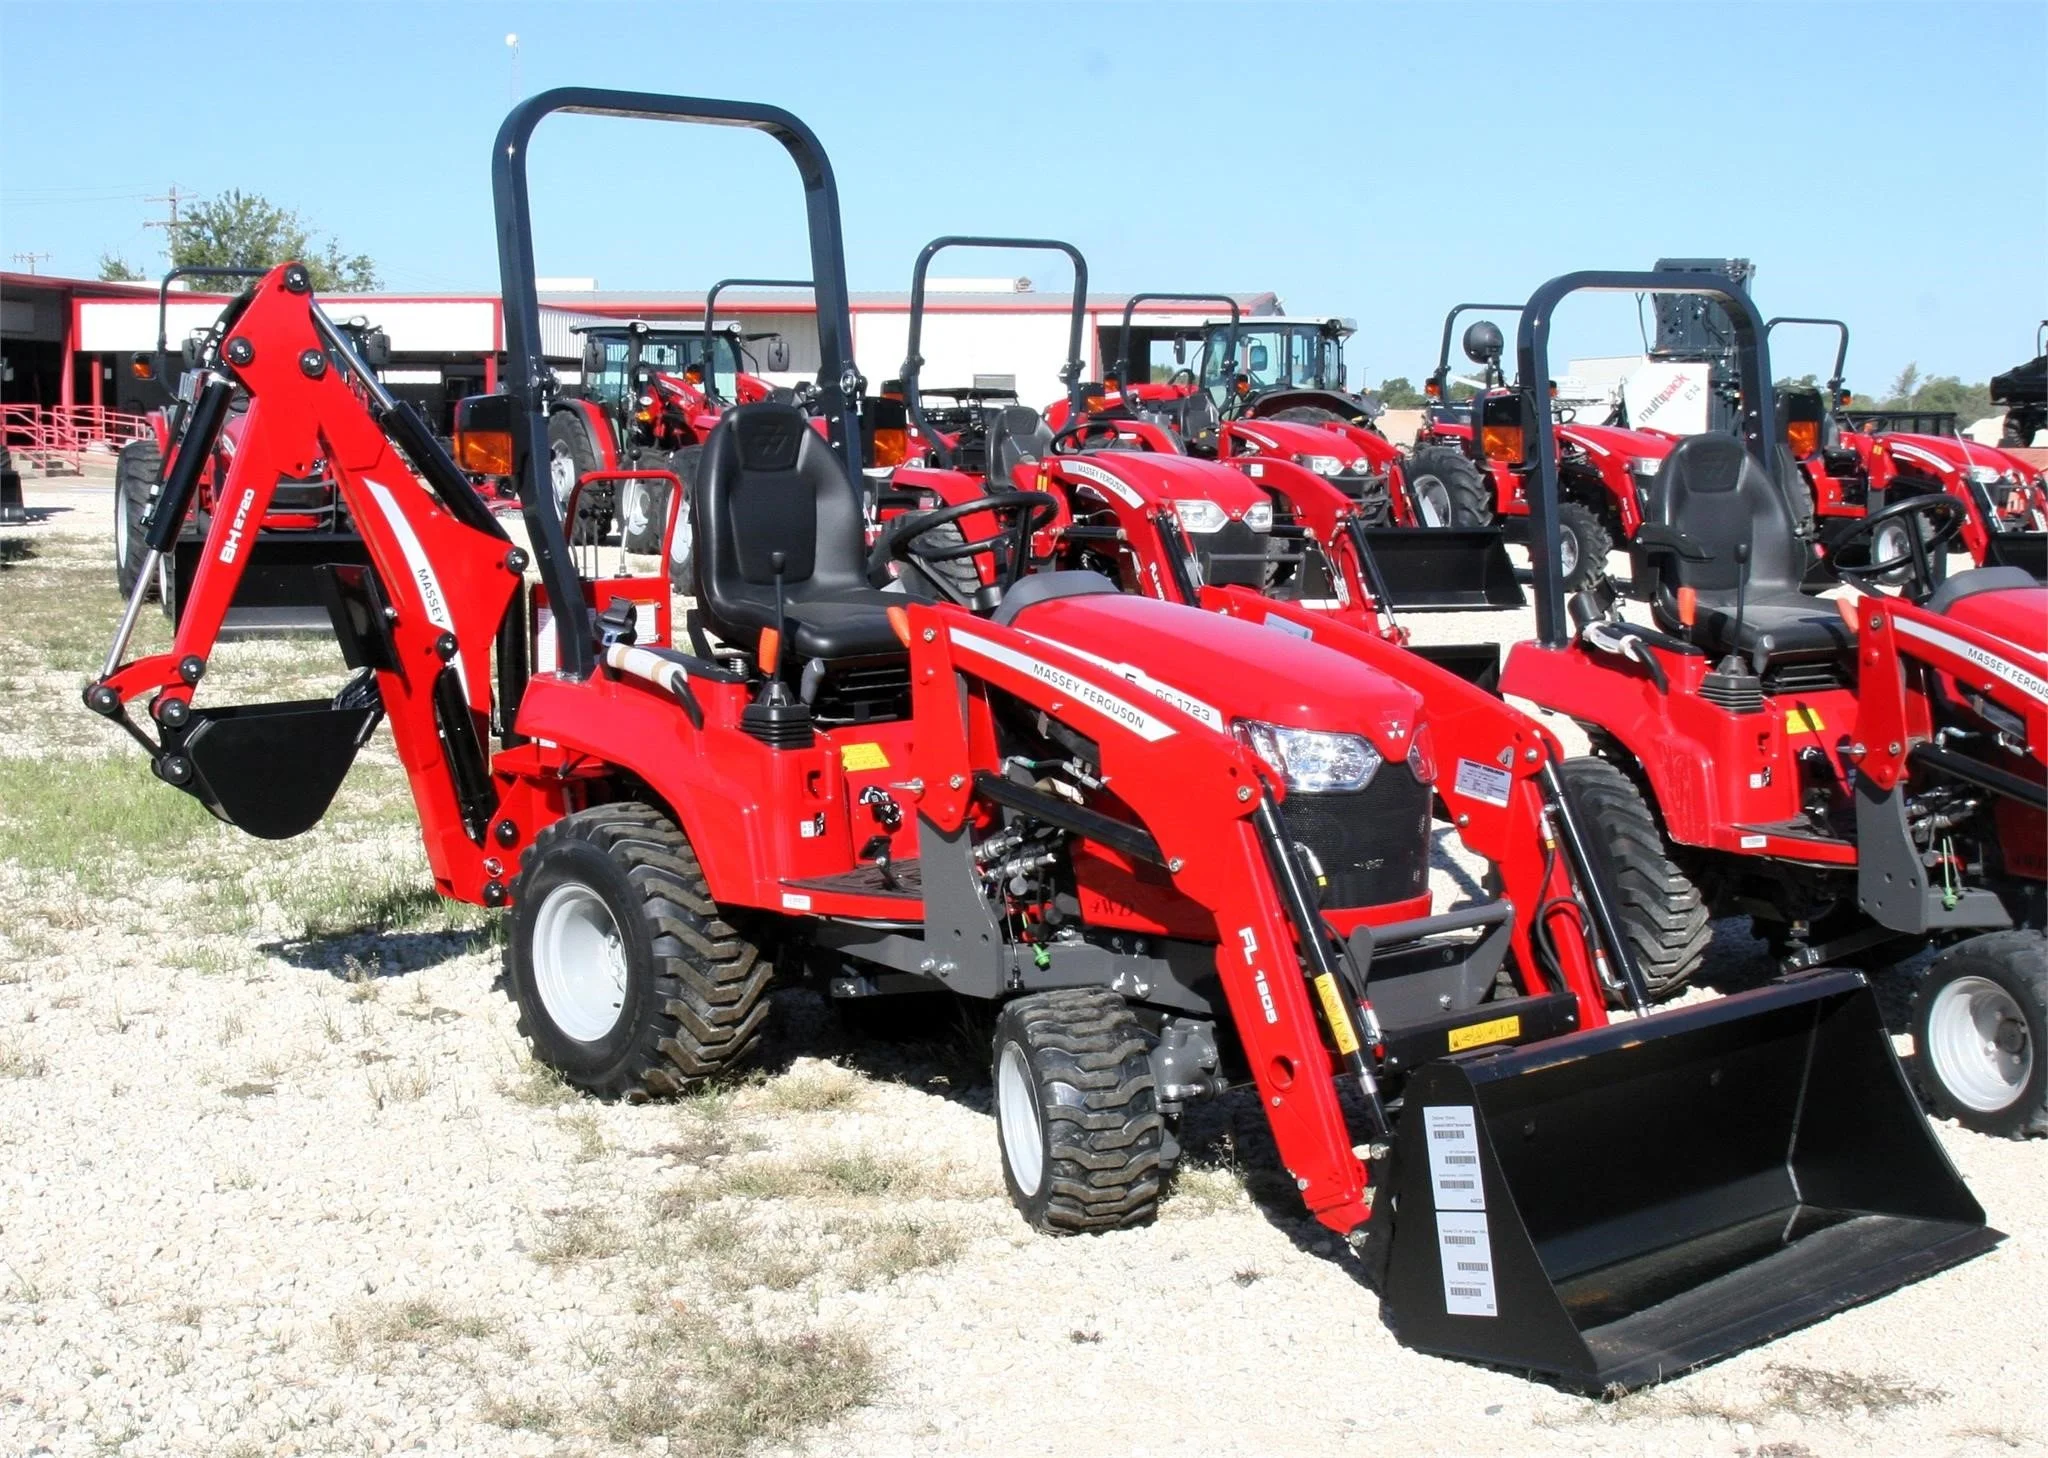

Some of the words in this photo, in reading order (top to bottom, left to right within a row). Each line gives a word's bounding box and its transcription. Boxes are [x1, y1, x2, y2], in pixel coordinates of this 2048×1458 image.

[1638, 372, 1691, 422] multipack
[1078, 464, 1099, 478] MASSEY
[1099, 472, 1127, 495] FERGUSON
[417, 568, 445, 623] MASSEY
[1967, 647, 2010, 675] MASSEY
[1033, 663, 1080, 692] MASSEY
[1083, 687, 1145, 729] FERGUSON
[1238, 926, 1258, 966] FL
